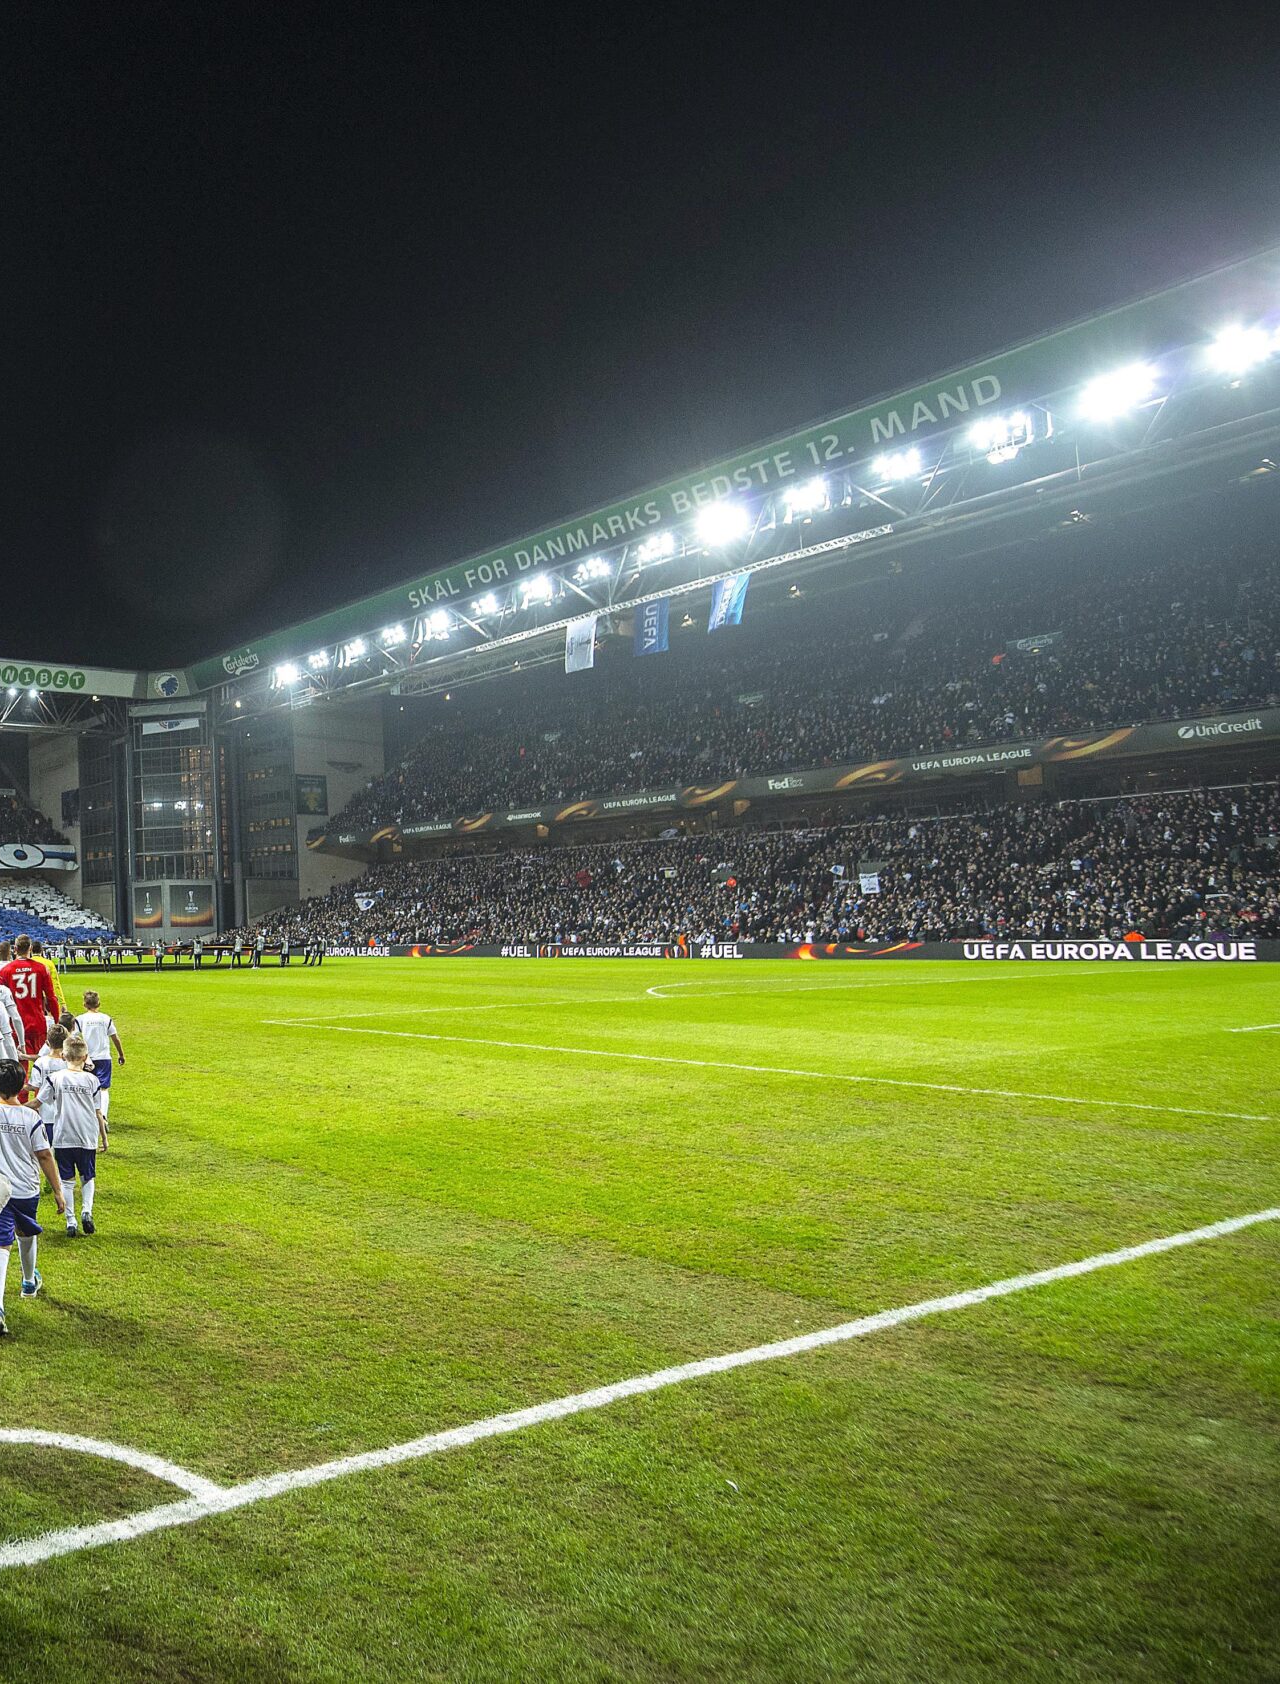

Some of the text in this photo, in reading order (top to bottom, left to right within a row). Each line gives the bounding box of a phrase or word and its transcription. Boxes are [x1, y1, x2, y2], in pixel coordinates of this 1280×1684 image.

[408, 374, 1002, 609] SKÅL FOR DANMARKS BEDSTE 12. MAND
[642, 603, 658, 649] UEFA
[222, 649, 259, 676] Carlsberg
[1194, 717, 1263, 738] UniCredit
[912, 749, 1032, 771] UEFA EUROPA LEAGUE
[603, 793, 676, 809] UEFA EUROPA LEAGUE
[432, 822, 452, 831] LEAGUE
[356, 947, 390, 957] LEAGUE
[501, 946, 531, 958] #UEL
[561, 947, 661, 957] UEFA EUROPA LEAGUE
[700, 945, 743, 958] #UEL
[962, 943, 1257, 961] UEFA EUROPA LEAGUE
[12, 973, 38, 999] 31
[0, 1125, 25, 1133] RESPECT
